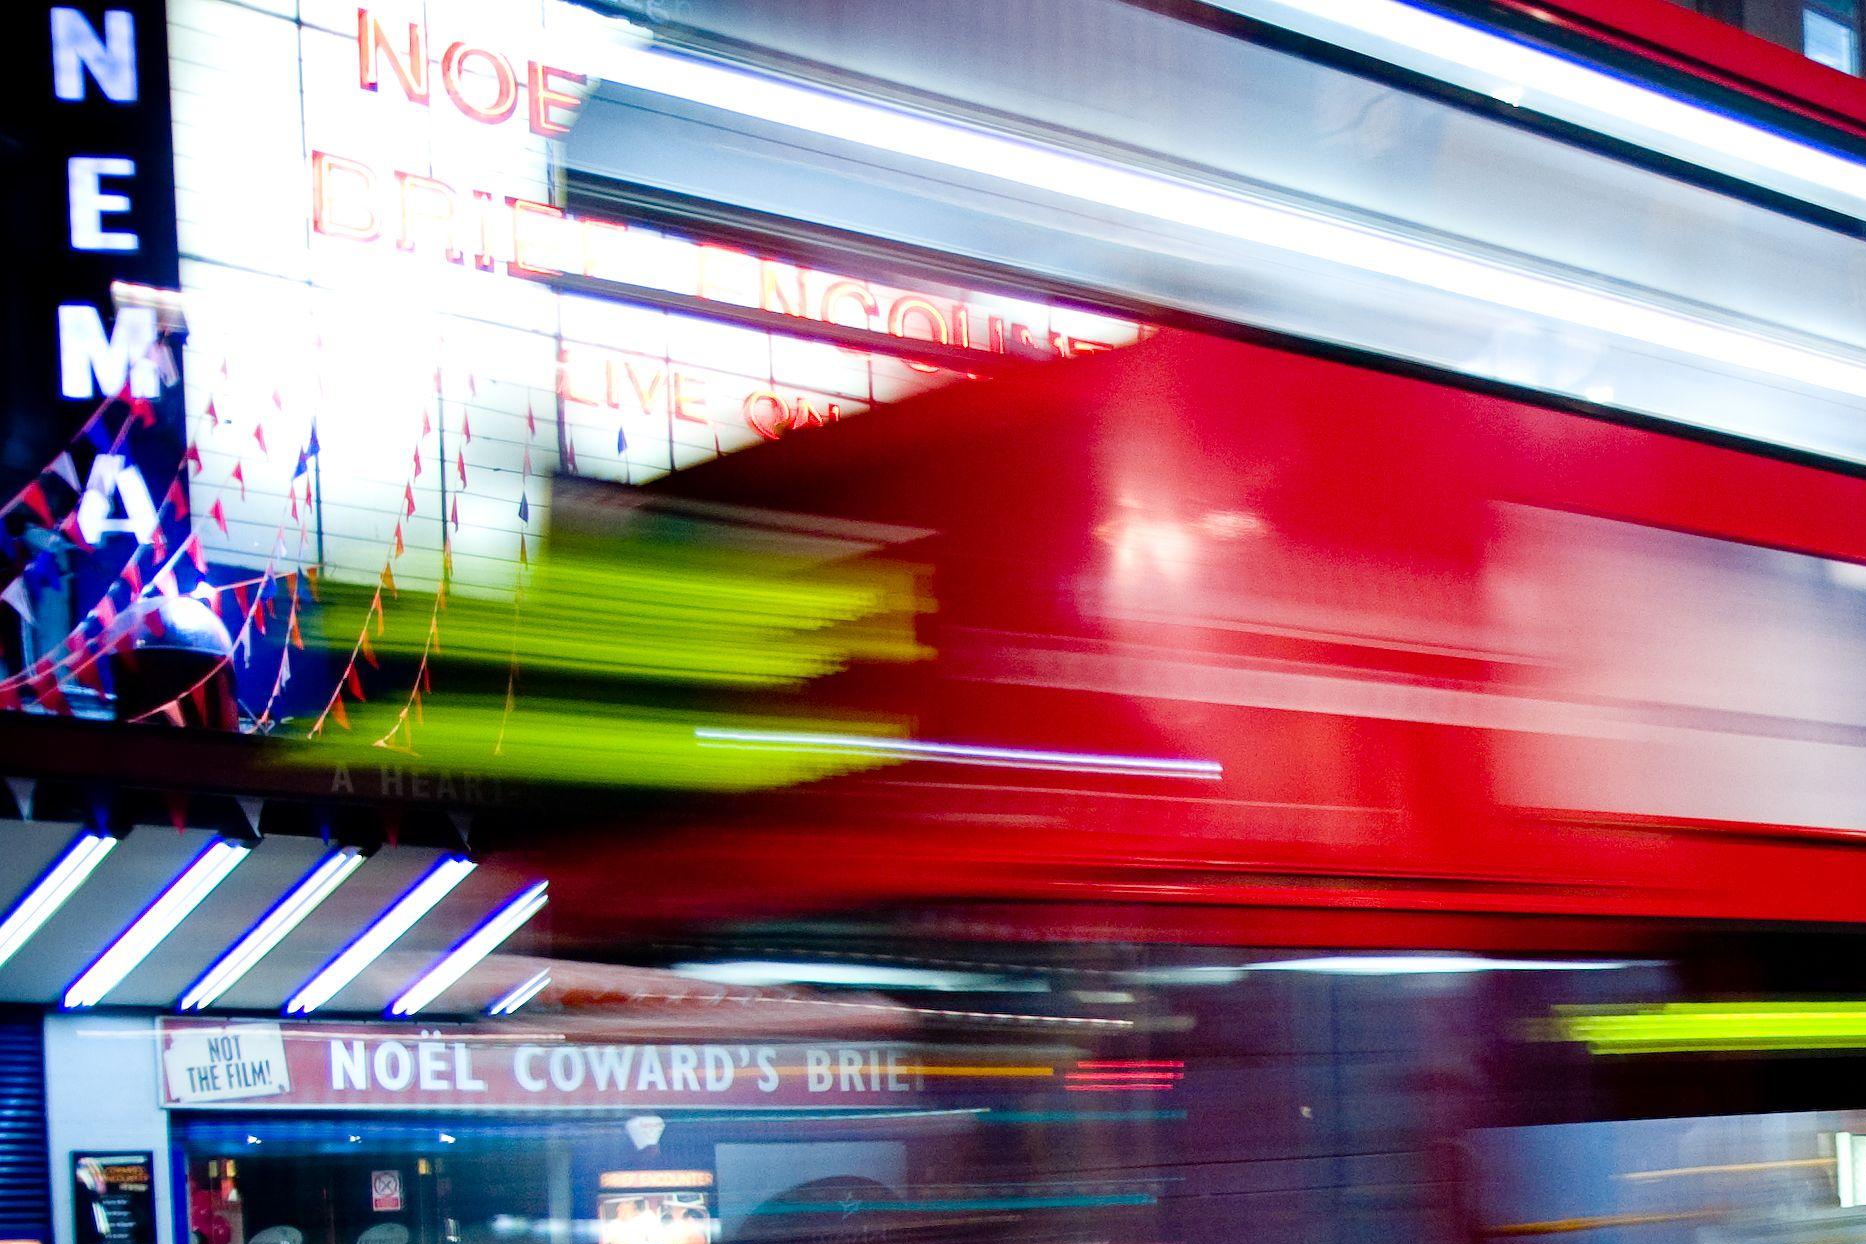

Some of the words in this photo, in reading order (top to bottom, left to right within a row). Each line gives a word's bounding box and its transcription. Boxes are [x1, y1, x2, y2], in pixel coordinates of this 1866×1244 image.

[556, 350, 708, 425] LIVE
[207, 1034, 241, 1063] NOT
[329, 1029, 489, 1092] NOËL
[513, 1044, 780, 1093] COWARD'S
[187, 1062, 224, 1094] THE
[225, 1060, 271, 1090] FILM!
